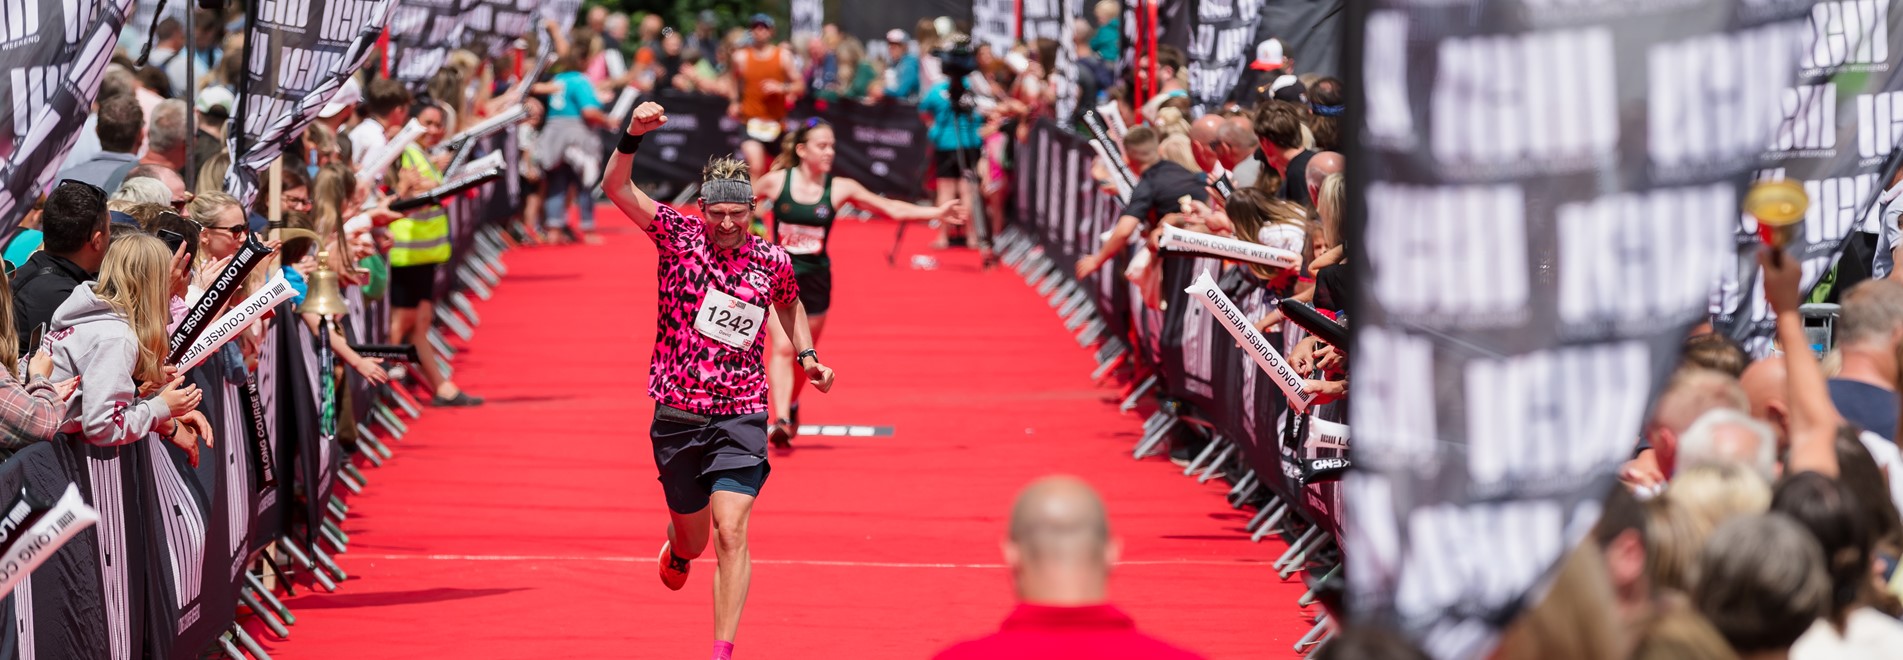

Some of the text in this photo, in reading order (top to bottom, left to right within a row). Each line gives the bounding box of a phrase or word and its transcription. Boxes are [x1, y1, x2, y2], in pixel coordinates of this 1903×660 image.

[2, 35, 40, 51] WEEKEND
[1183, 237, 1209, 247] LONG
[1210, 241, 1248, 256] COURSE
[216, 258, 244, 292] LONG
[182, 289, 220, 335] COURSE
[246, 290, 276, 316] LONG
[203, 313, 247, 348] COURSE
[707, 305, 754, 337] 1242
[1206, 288, 1302, 396] LONG COURSE WEEKEND
[249, 394, 266, 438] COURSE
[259, 439, 271, 470] LONG
[18, 523, 61, 562] LONG
